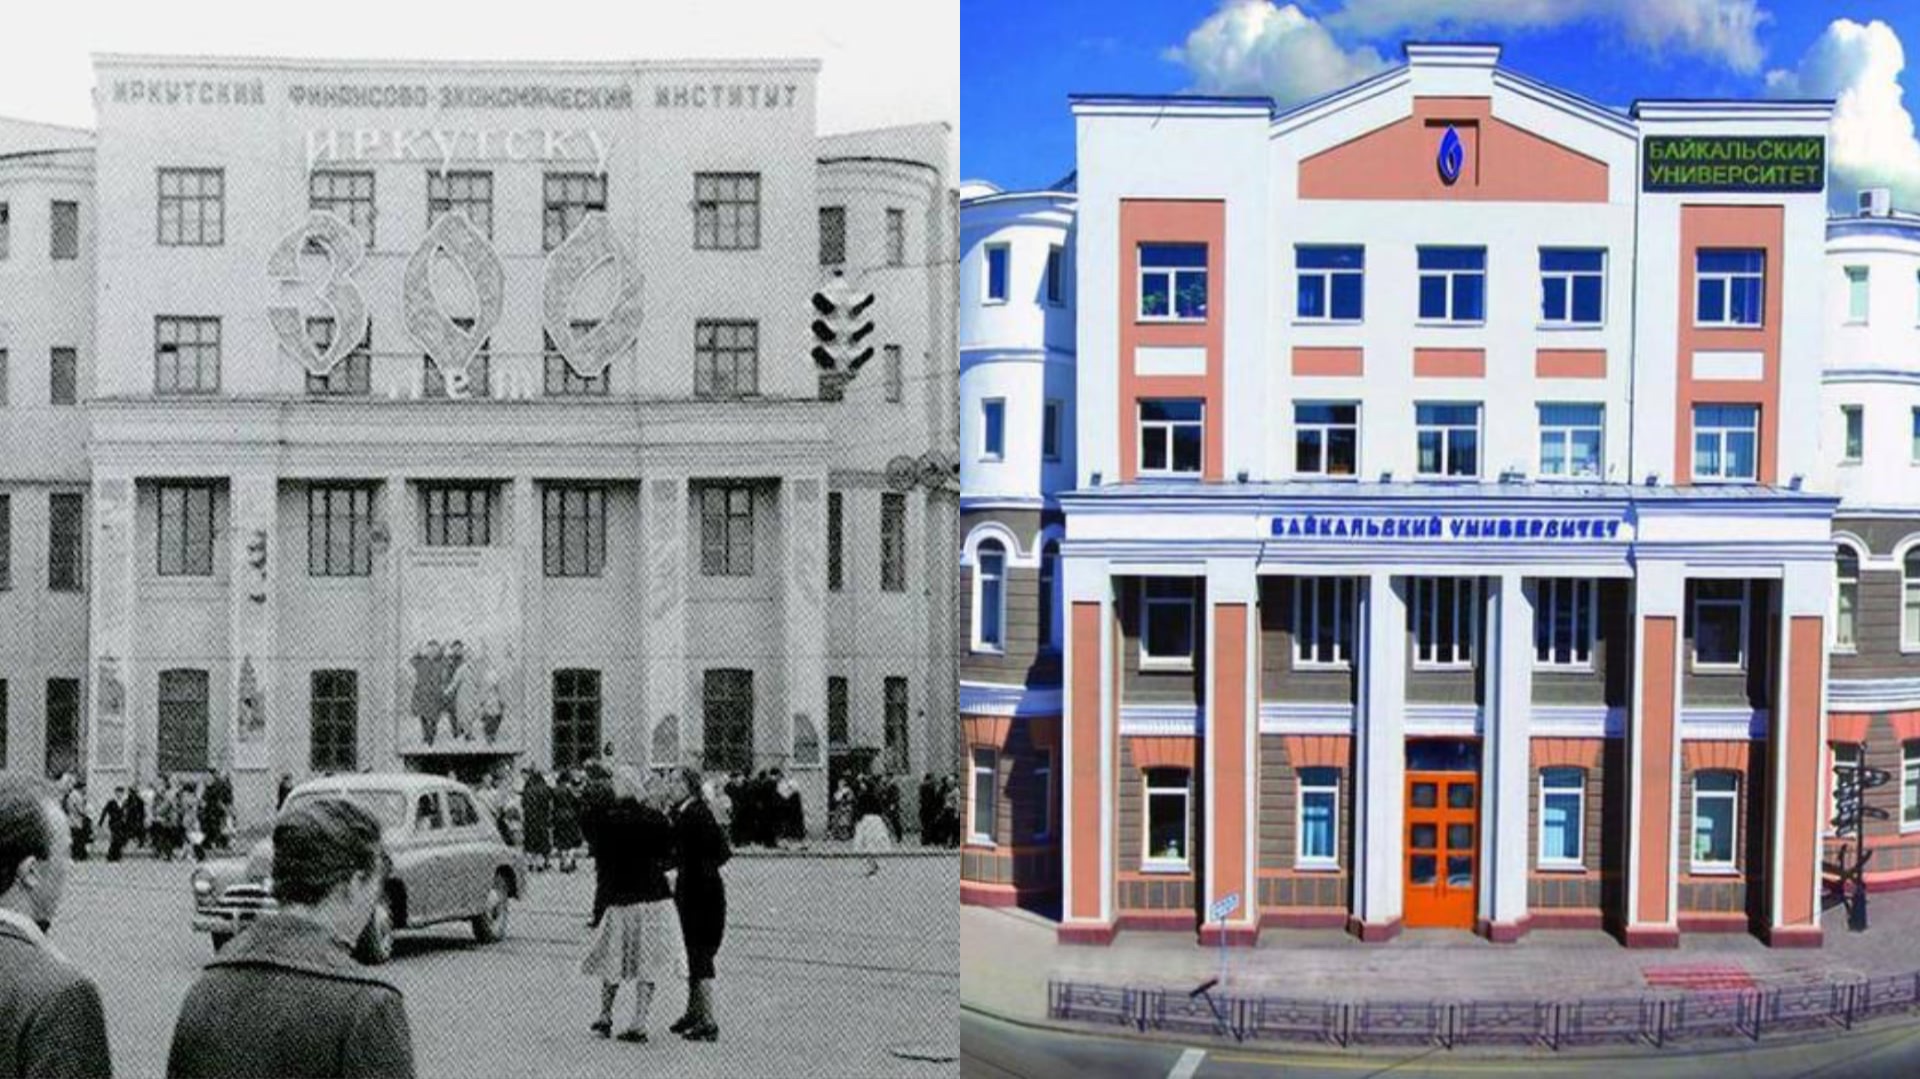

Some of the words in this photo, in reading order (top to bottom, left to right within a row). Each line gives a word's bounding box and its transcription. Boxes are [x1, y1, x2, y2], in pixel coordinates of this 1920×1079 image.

[1649, 138, 1821, 160] БАЙКАЛЬСКИЙ
[1649, 164, 1819, 184] УНИВЕРСИТЕТ
[1271, 515, 1443, 537] БАЙКАЛЬСКИЙ
[1450, 518, 1620, 539] УНИВЕРСИТЕТ
